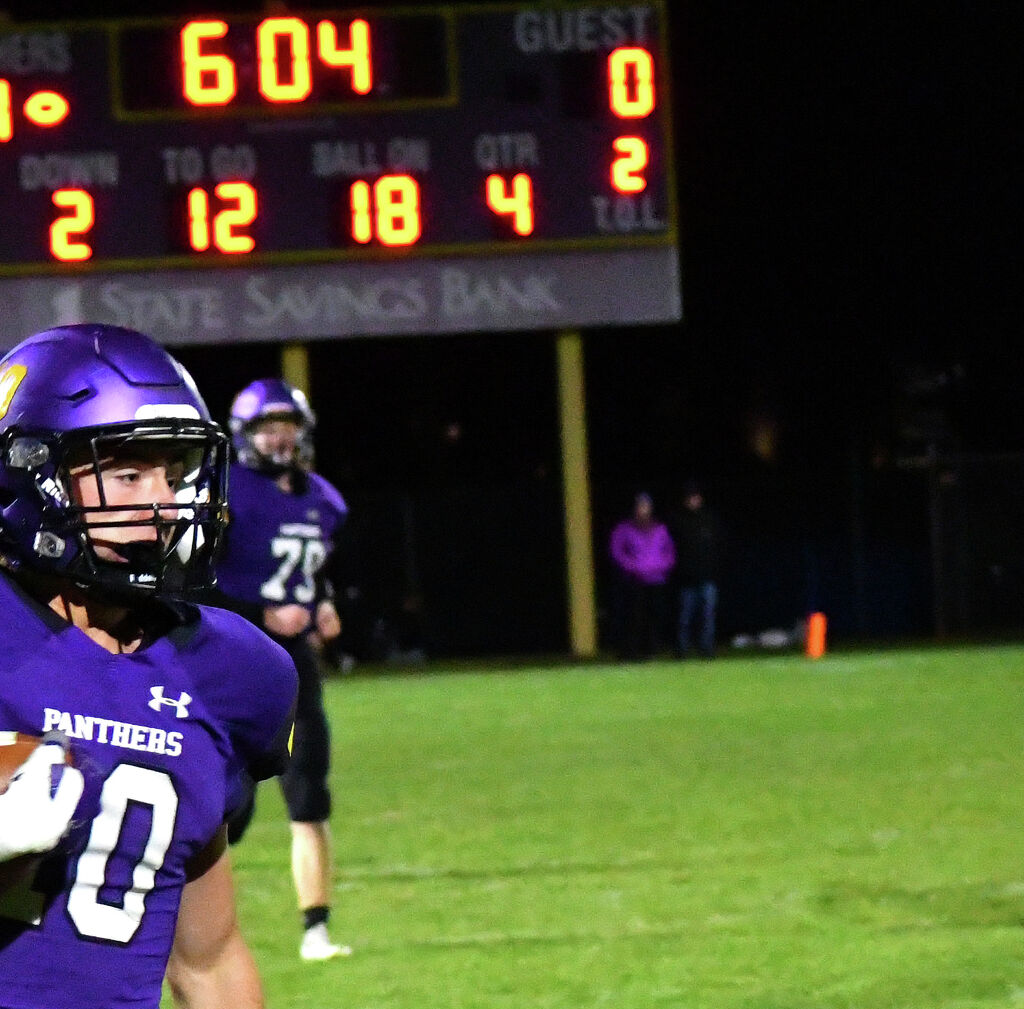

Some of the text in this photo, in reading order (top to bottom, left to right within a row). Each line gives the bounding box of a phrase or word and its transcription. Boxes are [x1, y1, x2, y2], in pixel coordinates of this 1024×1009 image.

[514, 8, 653, 51] GUEST
[608, 47, 655, 119] 0
[19, 152, 120, 190] DOWN
[163, 144, 258, 184] TO GO
[311, 136, 431, 178] BALL ON
[477, 132, 539, 168] QTR
[610, 135, 649, 194] 2
[49, 188, 95, 262] 2
[187, 180, 258, 254] 12
[350, 173, 422, 248] 18
[485, 172, 534, 236] 4
[101, 265, 564, 331] STATE SAVINGS BANK
[42, 706, 185, 757] PANTHERS
